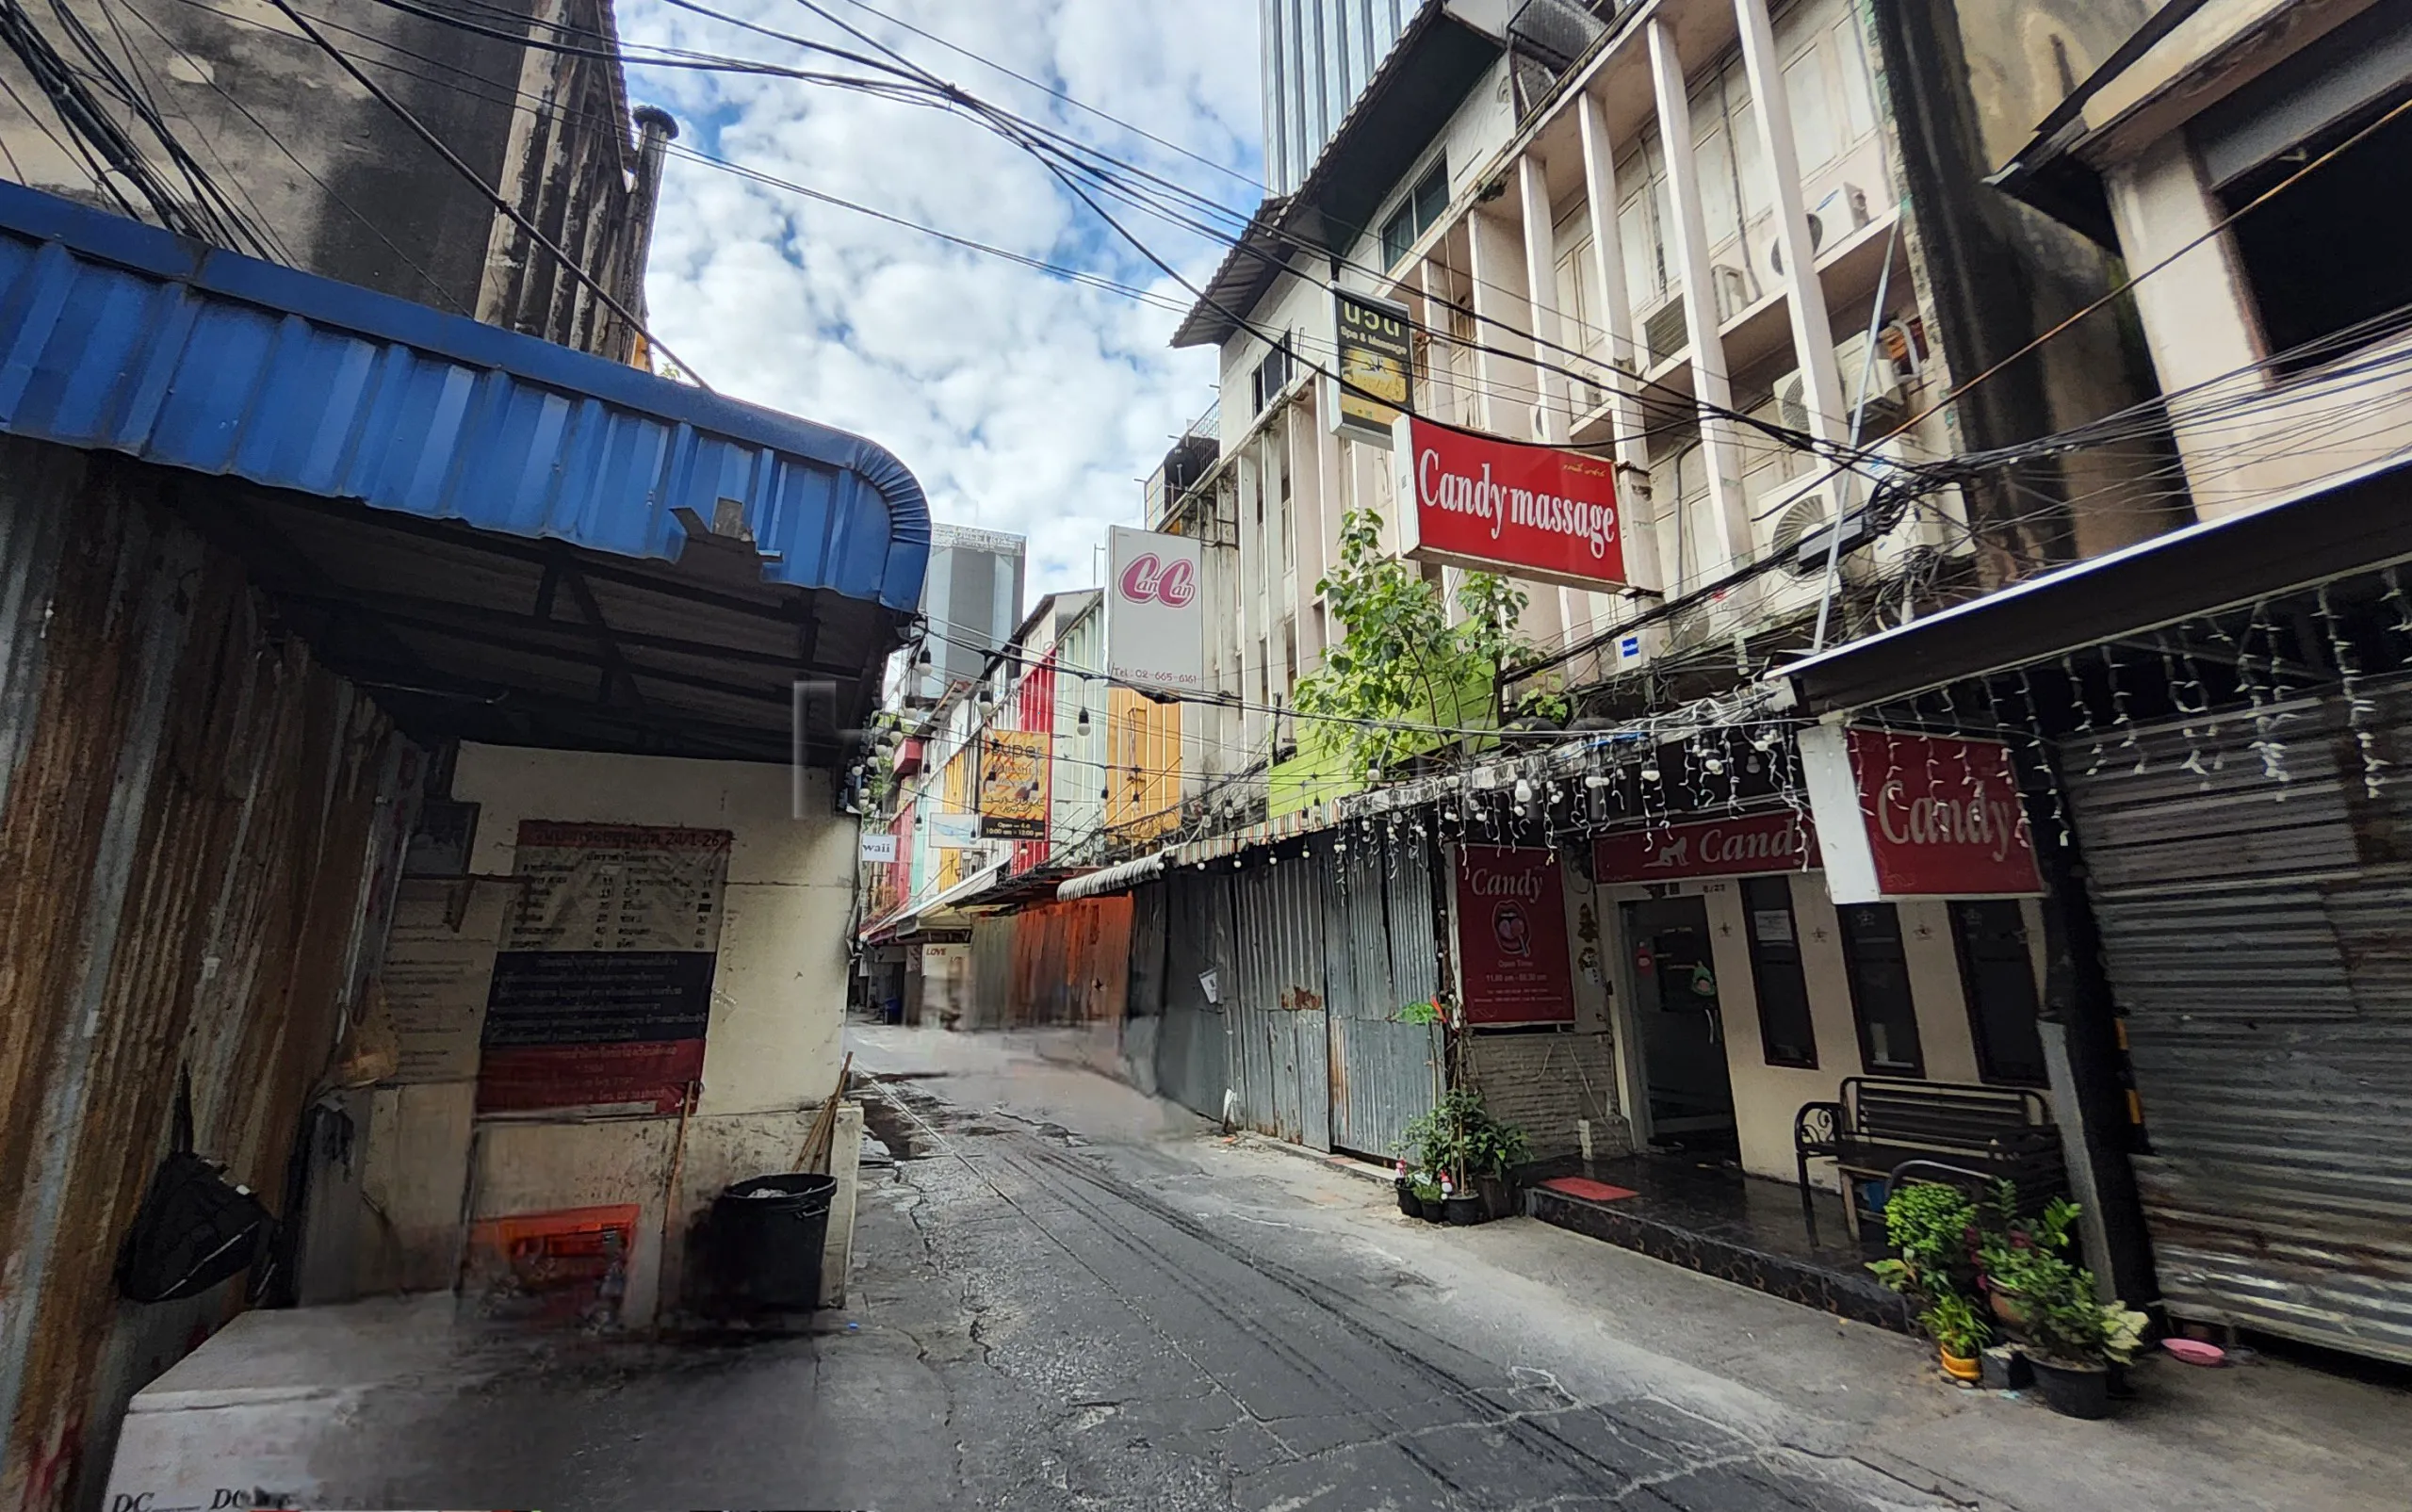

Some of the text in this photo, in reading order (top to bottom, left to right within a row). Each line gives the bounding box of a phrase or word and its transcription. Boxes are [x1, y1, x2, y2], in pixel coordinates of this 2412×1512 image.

[1419, 448, 1615, 559] Candy massage
[1877, 779, 2009, 862] Candy
[1472, 868, 1543, 903] Candy
[926, 948, 946, 956] LOVE
